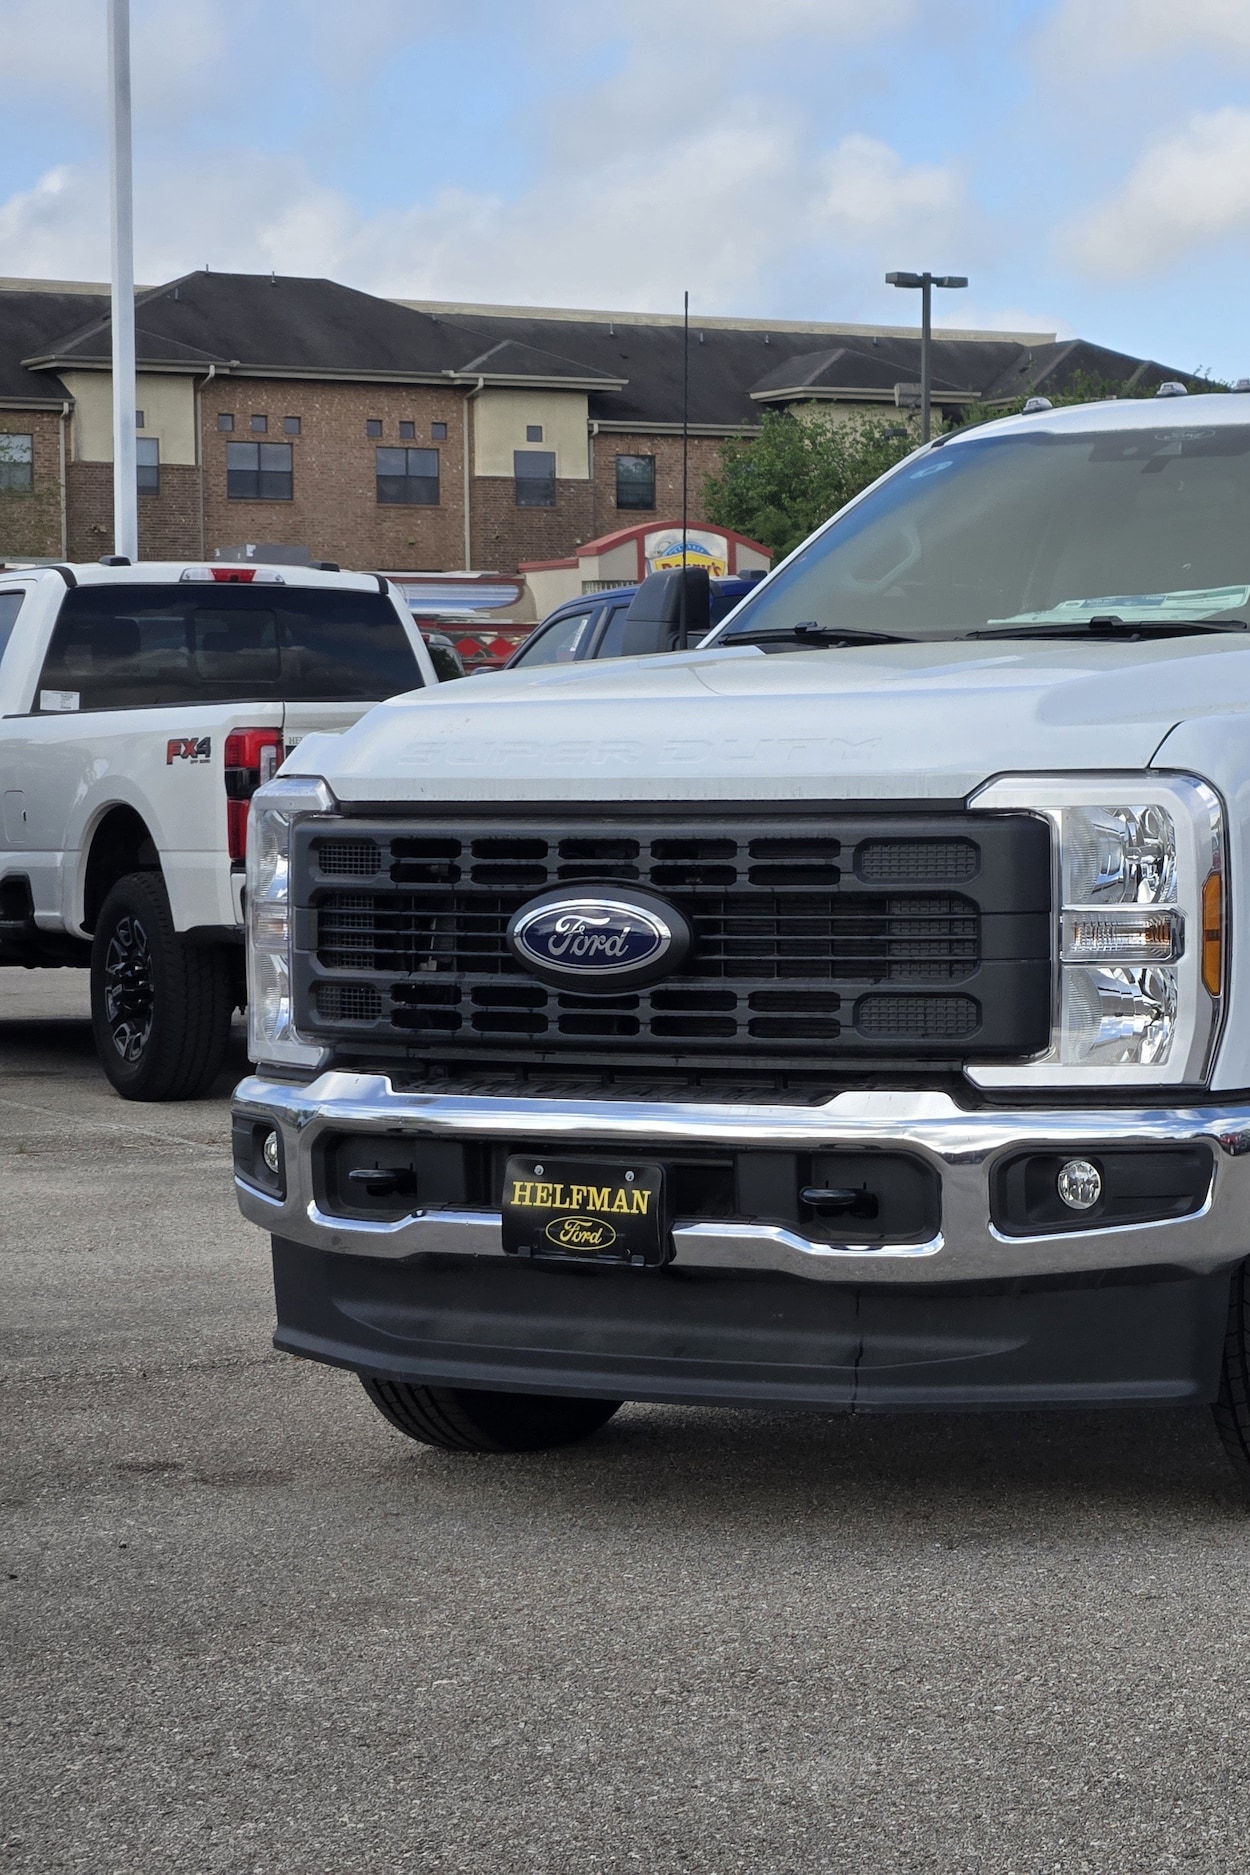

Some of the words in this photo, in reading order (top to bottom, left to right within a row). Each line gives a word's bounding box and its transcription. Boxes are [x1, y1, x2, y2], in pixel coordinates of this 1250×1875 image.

[166, 736, 211, 765] FX4
[399, 739, 638, 766] SUPER
[657, 737, 882, 765] DUTY
[548, 914, 631, 958] Ford
[510, 1181, 651, 1214] HELFMAN
[559, 1219, 603, 1245] Ford
